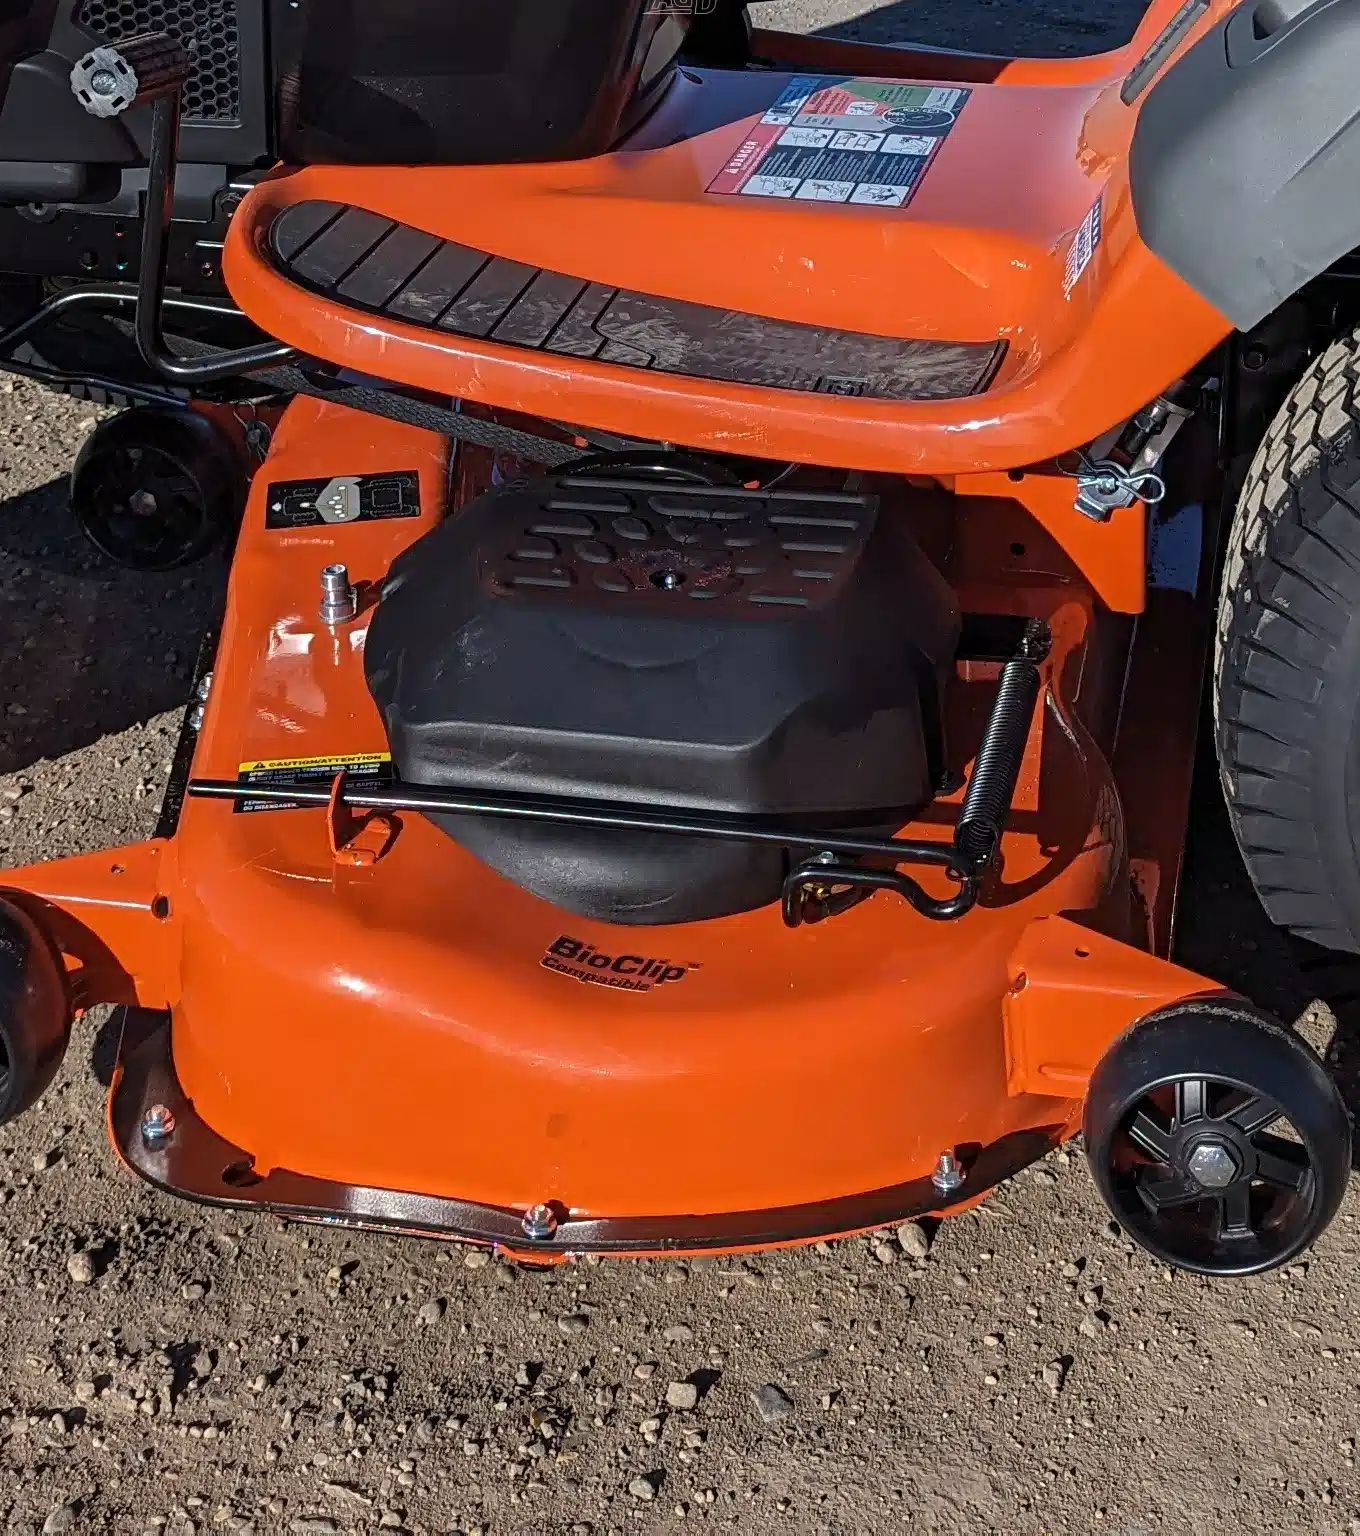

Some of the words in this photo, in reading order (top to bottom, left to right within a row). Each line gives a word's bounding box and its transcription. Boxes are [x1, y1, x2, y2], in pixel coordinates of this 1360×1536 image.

[732, 139, 759, 171] DANGER
[268, 754, 382, 768] CAUTION/ATTENTION
[541, 955, 652, 992] Compatible
[547, 934, 687, 985] BioClip
